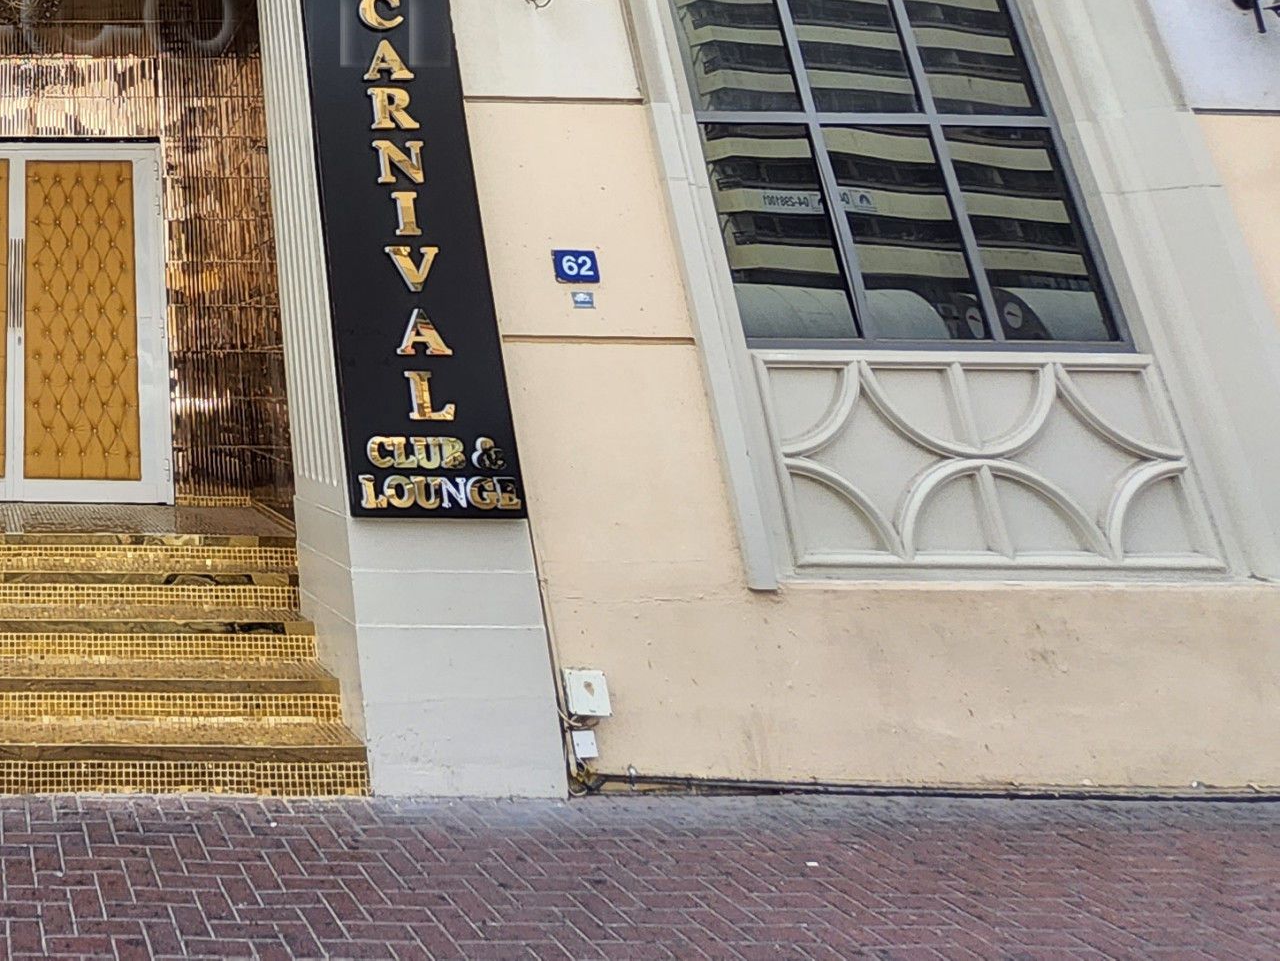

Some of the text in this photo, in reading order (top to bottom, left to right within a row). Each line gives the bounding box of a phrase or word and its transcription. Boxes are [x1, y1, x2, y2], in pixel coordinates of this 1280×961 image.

[562, 255, 595, 276] 62
[366, 435, 508, 470] CLUB &
[357, 474, 522, 510] LOUNGE
